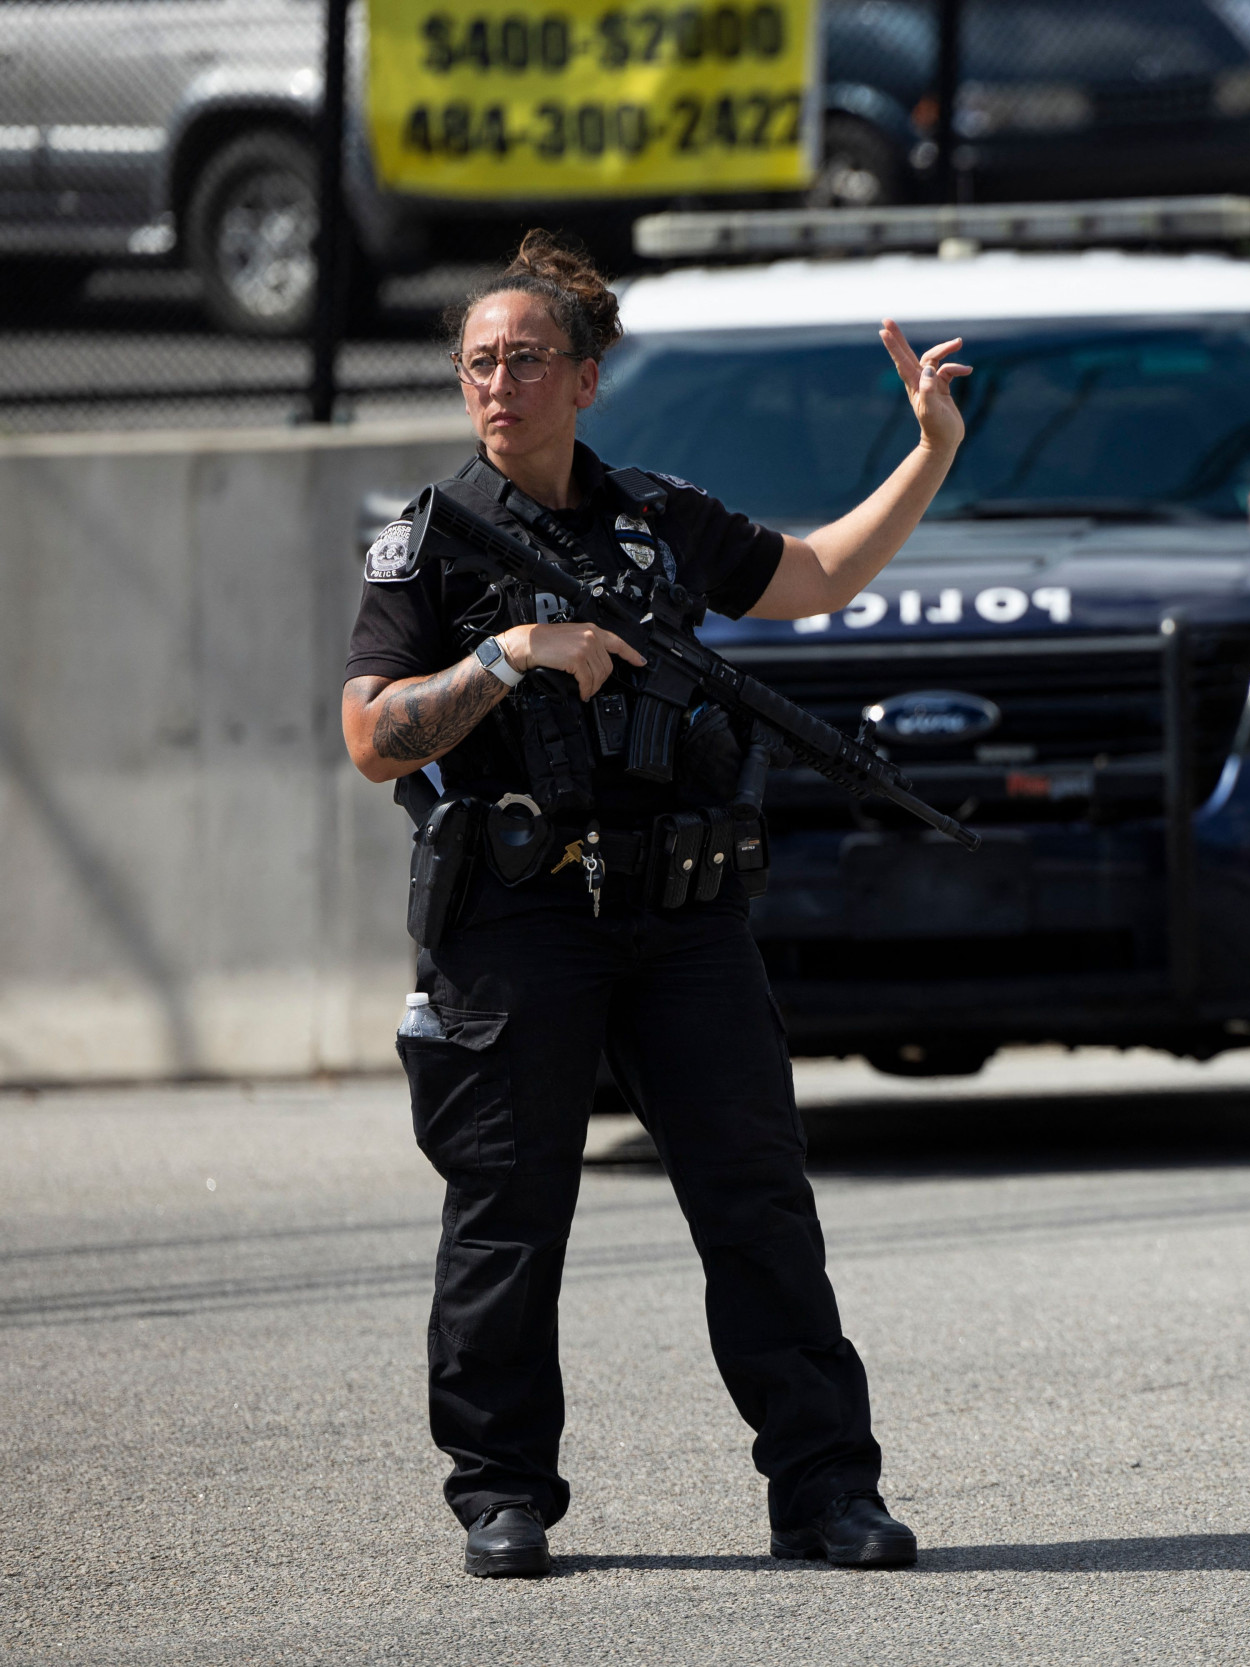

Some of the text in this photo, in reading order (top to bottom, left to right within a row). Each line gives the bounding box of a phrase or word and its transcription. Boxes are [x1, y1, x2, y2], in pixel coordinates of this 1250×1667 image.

[420, 3, 786, 73] $400-$2000
[404, 93, 801, 160] 484-300-2422
[370, 570, 397, 578] POLICE
